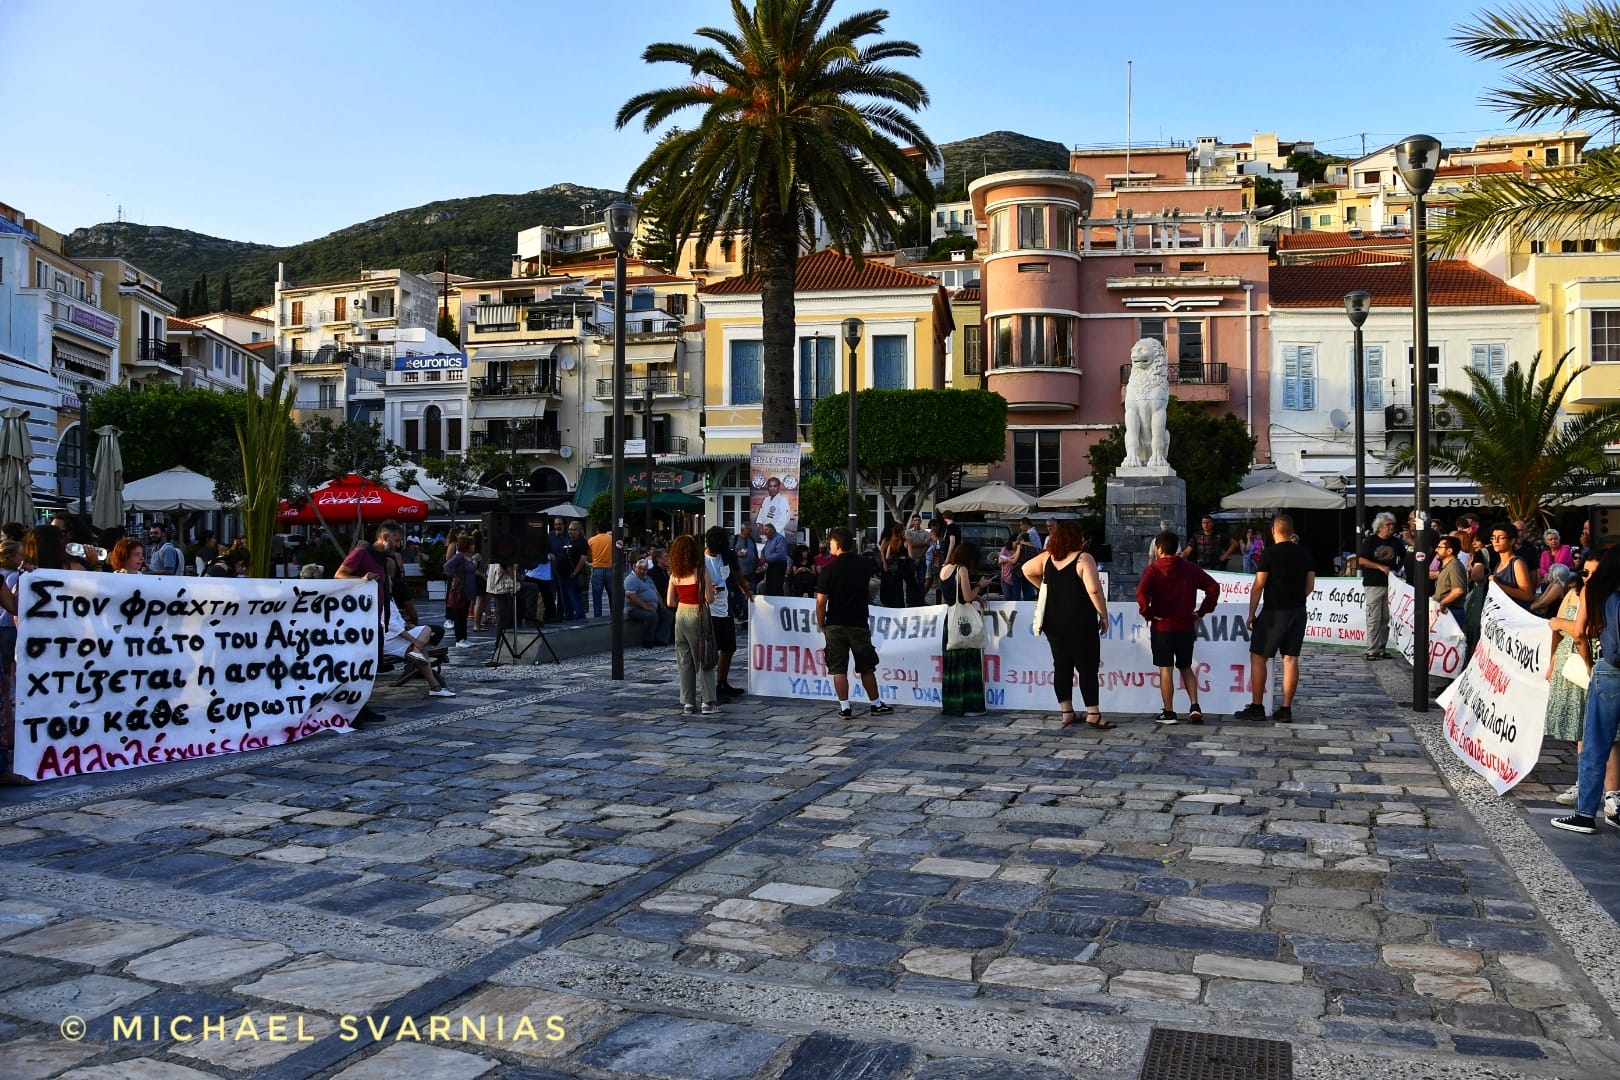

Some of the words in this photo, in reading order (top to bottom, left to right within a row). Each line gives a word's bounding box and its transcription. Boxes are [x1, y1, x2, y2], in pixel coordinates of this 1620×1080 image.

[412, 356, 462, 368] euronics
[1448, 498, 1480, 506] MAD
[26, 580, 110, 618] Στον
[248, 598, 288, 614] του
[25, 637, 113, 658] στον
[124, 625, 205, 657] πάτο
[215, 631, 258, 650] του
[1305, 626, 1332, 638] ΕΝΤΡΟ
[1338, 628, 1366, 641] ΣΑΜΟΥ
[28, 660, 187, 704] χτίζεται
[198, 666, 215, 686] η
[225, 654, 374, 689] ασφάλεια
[24, 716, 90, 743] του
[104, 696, 190, 732] κάθε
